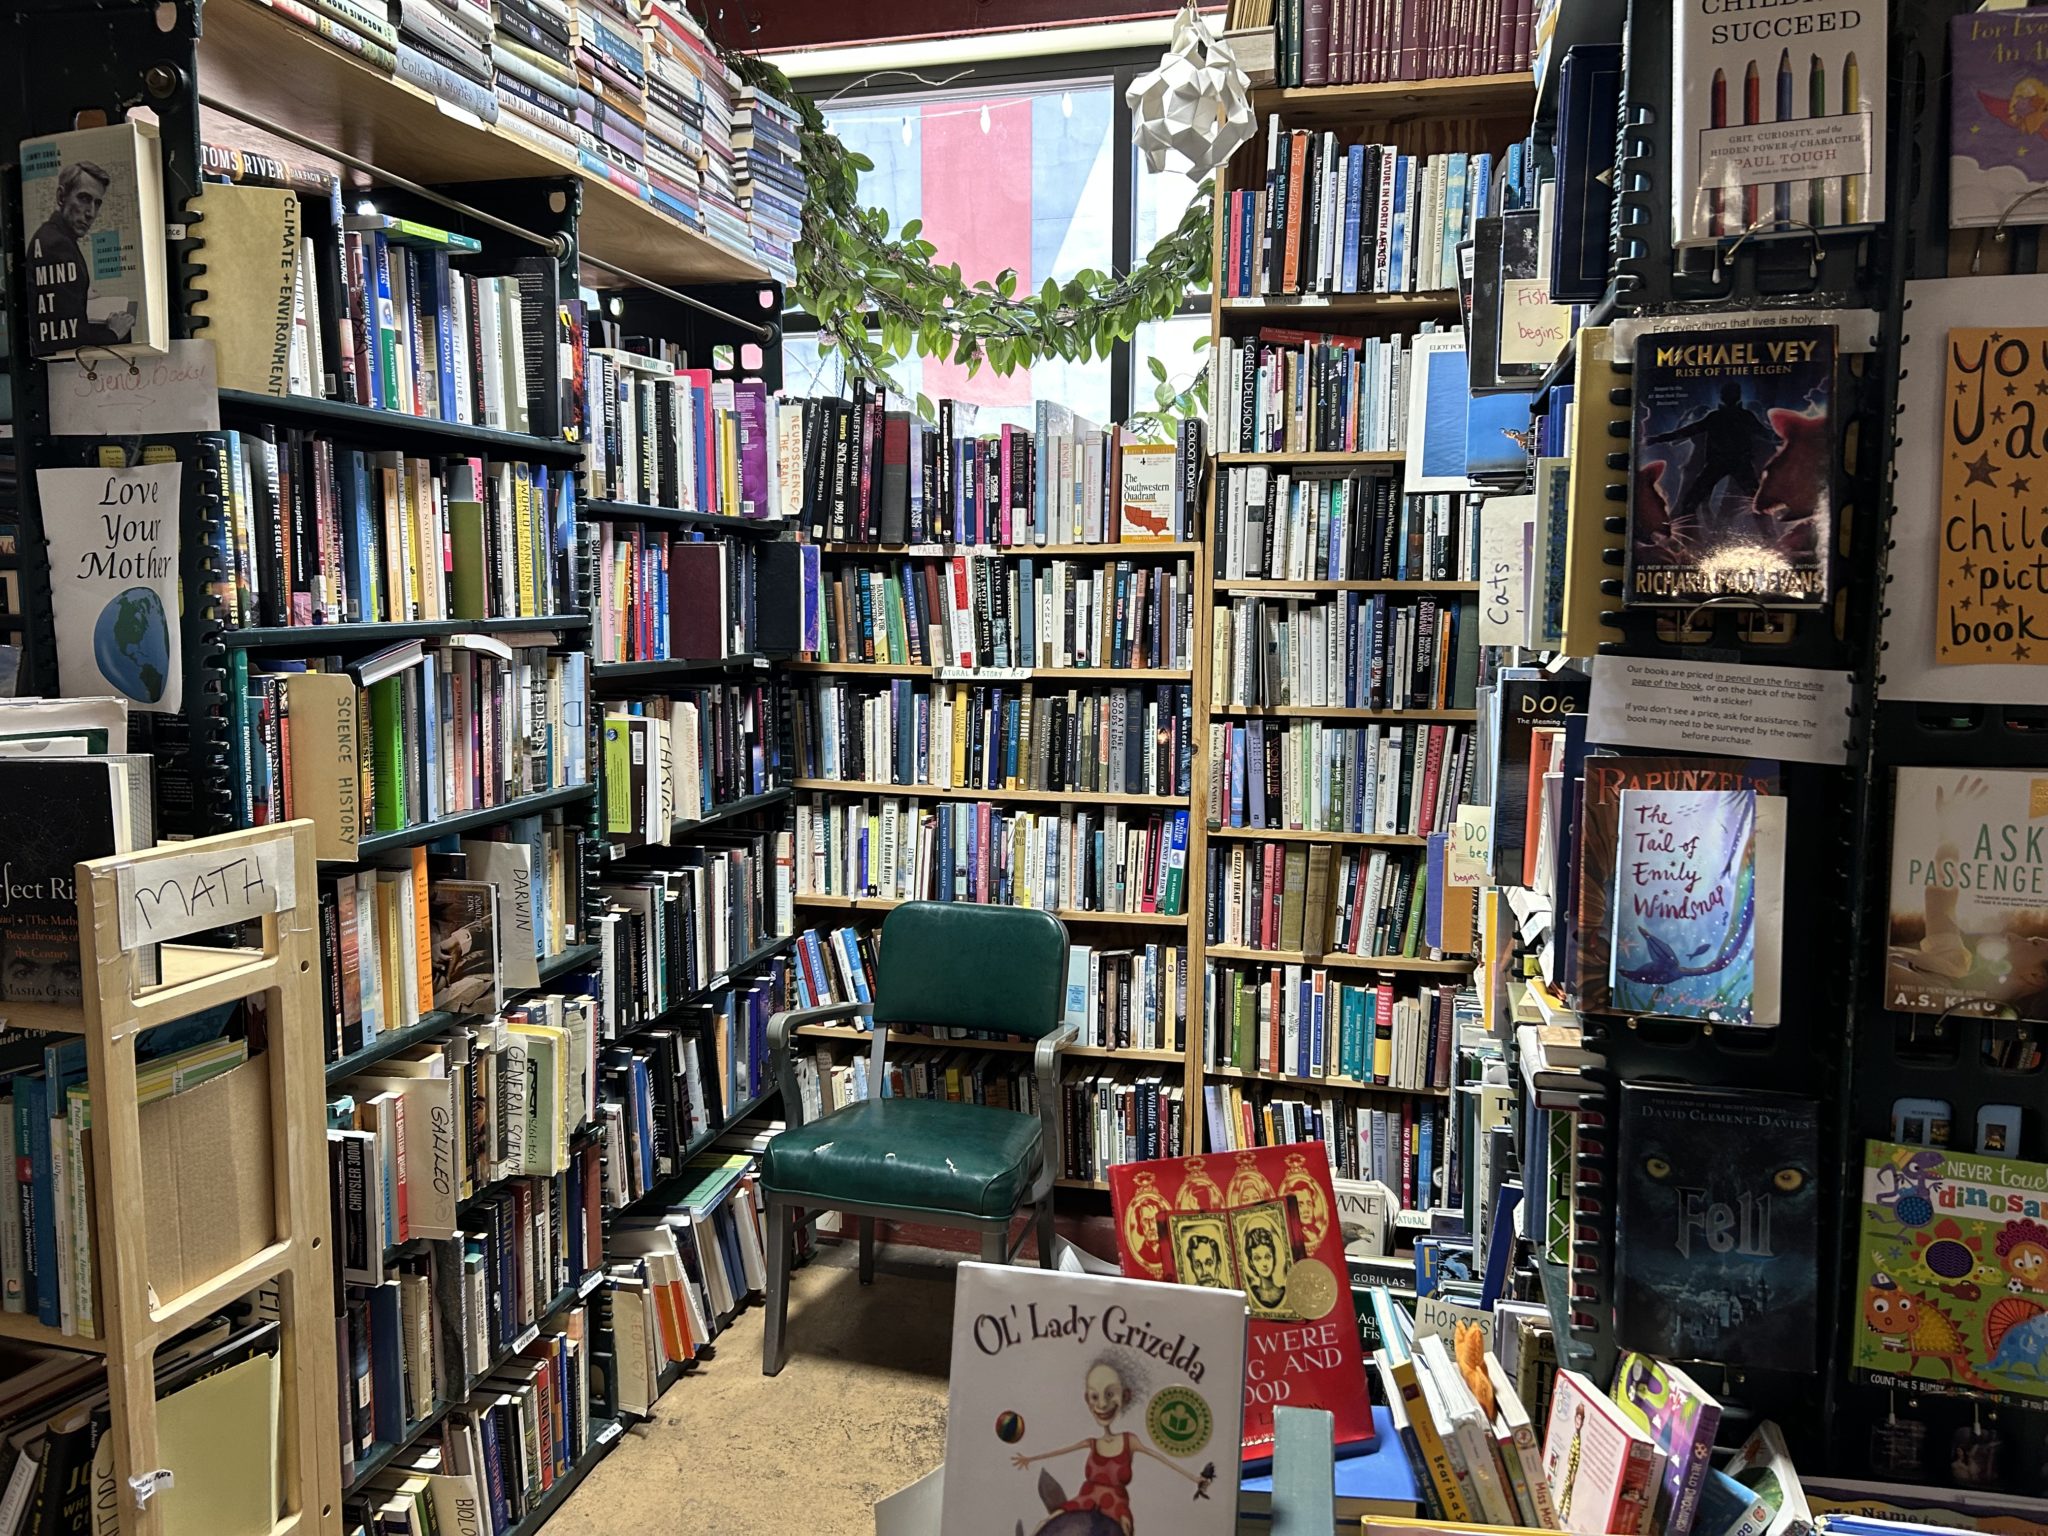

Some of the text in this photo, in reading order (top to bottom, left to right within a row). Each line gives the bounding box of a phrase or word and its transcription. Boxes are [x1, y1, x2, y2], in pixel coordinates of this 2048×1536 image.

[349, 9, 383, 33] SIMPSON
[1711, 10, 1861, 45] SUCCEED
[1970, 19, 2008, 41] For
[401, 58, 442, 86] Collected
[445, 77, 473, 101] Stories
[1710, 134, 1862, 157] HIDDEN POWER CHARACTER
[1728, 124, 1842, 144] GRIT, CURIOSITY, and the
[201, 147, 285, 180] TOMS RIVER
[1734, 149, 1838, 169] PAUL TOUGH
[1380, 152, 1393, 229] NATURE IN NORTH
[34, 238, 43, 258] A
[36, 262, 78, 287] MIND
[38, 293, 56, 314] AT
[267, 196, 295, 397] CLIMATE ENVIRONMENT
[40, 318, 78, 342] PLAY
[1518, 321, 1564, 348] begins
[1729, 314, 1817, 328] that lives is holy;
[1656, 340, 1818, 367] MICHAEL VEY
[1675, 364, 1793, 378] RISE OF THE ELGEN
[1241, 343, 1255, 441] GREEN DELUSIONS
[780, 450, 789, 487] BRAIN
[789, 414, 801, 512] NEUROSCIENCE/
[1186, 422, 1197, 491] GEOLOGY TODAY
[219, 450, 228, 497] RESCUING
[1123, 483, 1170, 493] Southwestern
[1125, 474, 1138, 486] The
[98, 476, 158, 506] Love
[1123, 492, 1156, 502] Quadrant
[294, 496, 304, 534] skeptical
[101, 514, 161, 549] Your
[273, 524, 283, 559] SEQUEL
[520, 484, 531, 592] WORLDCHANGING
[76, 546, 171, 580] Mother
[1487, 562, 1510, 625] Cats
[1626, 664, 1643, 674] Our
[1644, 667, 1670, 677] books
[1686, 671, 1714, 681] priced
[1715, 672, 1724, 681] in
[1725, 674, 1752, 685] pencil
[1766, 677, 1782, 686] the
[1784, 678, 1801, 687] first
[1802, 682, 1824, 690] white
[1631, 676, 1652, 688] page
[1654, 678, 1663, 686] of
[1664, 679, 1679, 688] the
[1680, 681, 1704, 691] book,
[1730, 685, 1745, 695] the
[1747, 687, 1767, 697] back
[1769, 689, 1780, 697] of
[1781, 690, 1796, 699] the
[1797, 691, 1817, 701] book
[1521, 695, 1576, 715] DOG
[1625, 702, 1632, 711] If
[1633, 705, 1649, 716] you
[1649, 704, 1672, 715] don't
[1673, 708, 1688, 716] see
[1697, 710, 1721, 721] price,
[1722, 712, 1737, 720] ask
[1739, 712, 1753, 722] for
[1753, 715, 1801, 727] assistance.
[1802, 719, 1818, 729] The
[1692, 694, 1712, 704] with
[1720, 697, 1753, 707] sticker!
[534, 692, 545, 756] EDISON
[1517, 717, 1561, 727] The Meaning
[1626, 713, 1813, 740] book may need to be surveyed by the owner
[1681, 731, 1753, 746] before purchase.
[272, 758, 280, 789] NEXT
[336, 695, 355, 846] SCIENCE HISTORY
[1366, 779, 1374, 814] CIRCLE
[1634, 804, 1673, 825] The
[1635, 828, 1701, 860] Tail of
[1973, 823, 2045, 865] ASK
[1233, 851, 1242, 905] GRIZZLY HEART
[1453, 871, 1481, 882] begins
[1632, 861, 1701, 894] Emily
[1909, 858, 2044, 894] PASSENGE
[134, 856, 265, 930] MATH
[512, 867, 532, 932] DARWIN
[1634, 884, 1726, 921] Windsnap
[1894, 992, 1937, 1008] A.S.
[507, 1045, 526, 1175] GENERAL SCIENCE
[1147, 1091, 1156, 1157] Wildlife Wars
[1641, 1105, 1686, 1120] DAVID
[1689, 1109, 1811, 1130] CLEMENT-DAVIES
[430, 1105, 450, 1196] GALILEO
[349, 1140, 361, 1211] CHRYSLER 300M
[1947, 1159, 1993, 1182] NEVER
[1674, 1185, 1775, 1259] Fell
[1353, 1272, 1406, 1288] GORILLAS
[973, 1302, 1206, 1385] OL' Lady Grizelda
[1253, 1323, 1339, 1356] WERE
[1283, 1347, 1342, 1376] AND
[1869, 1373, 1917, 1391] COUNT THE 5
[1432, 1455, 1449, 1485] Bear
[1688, 1462, 1703, 1487] HELLO
[1534, 1481, 1548, 1506] Miss
